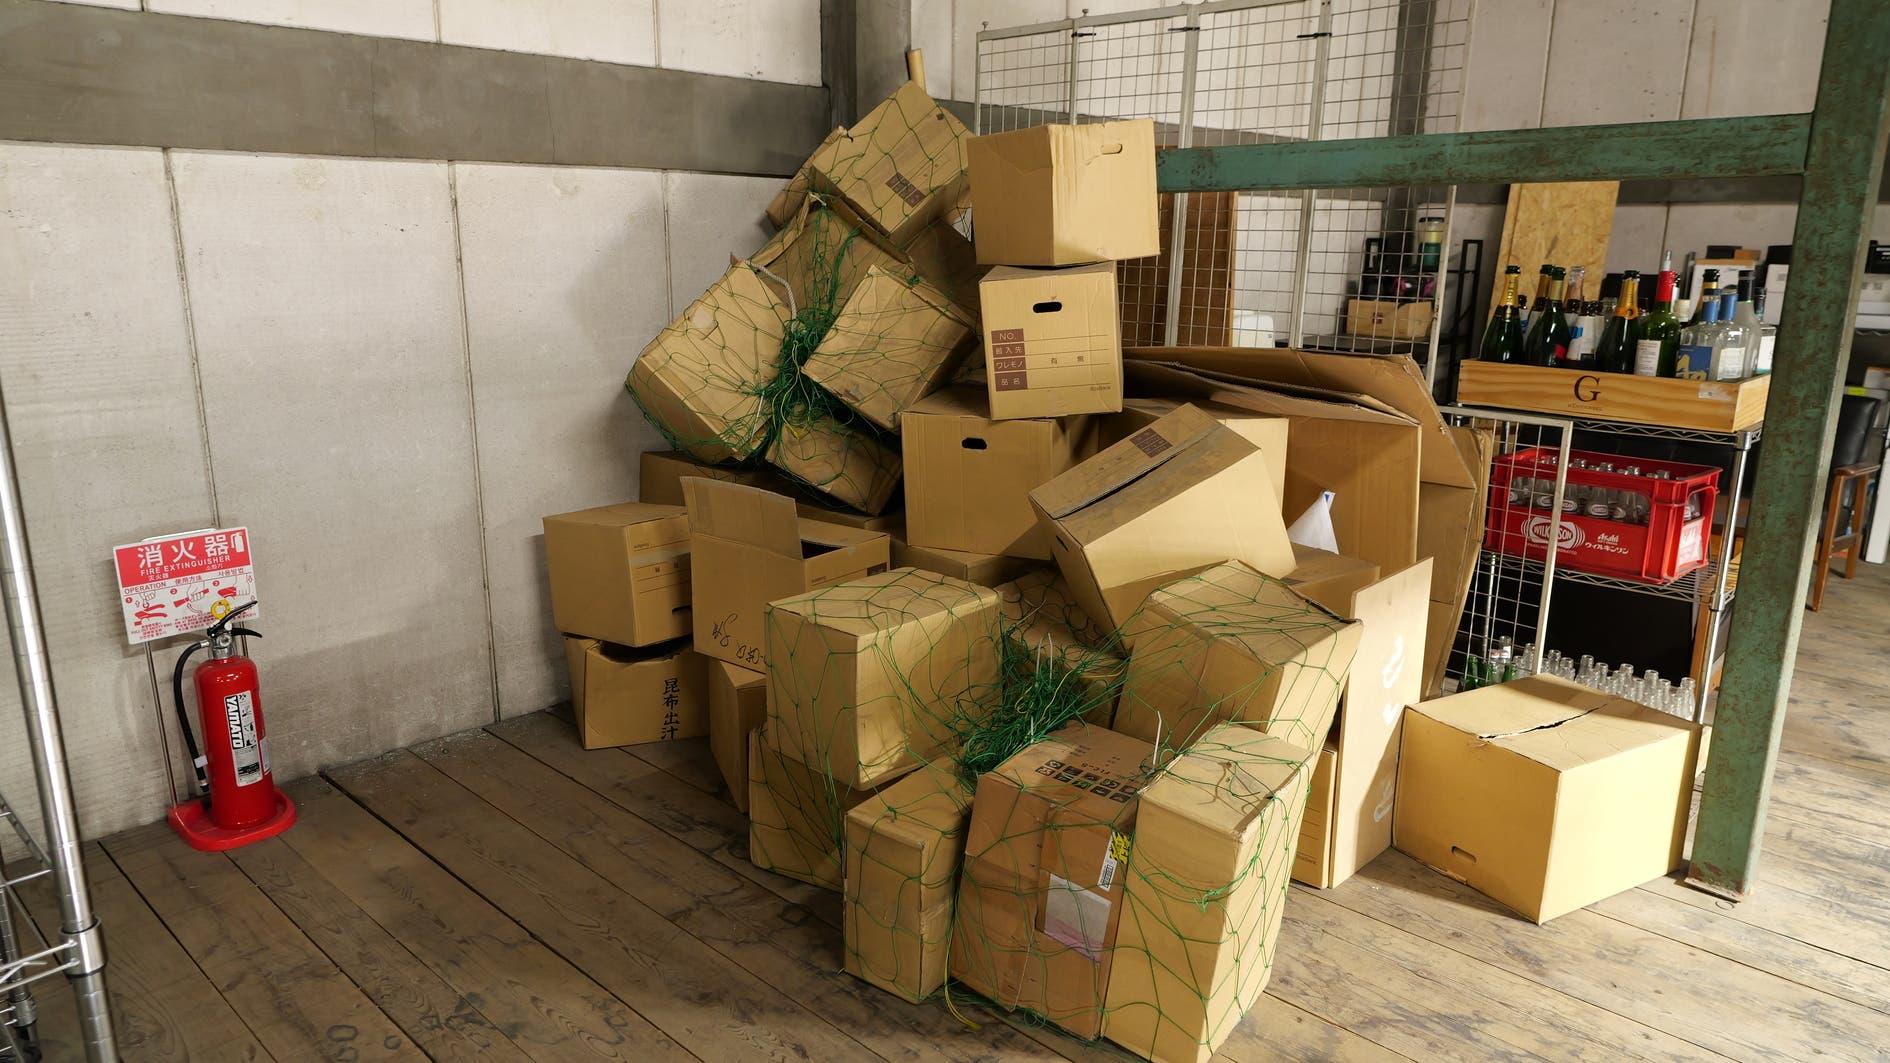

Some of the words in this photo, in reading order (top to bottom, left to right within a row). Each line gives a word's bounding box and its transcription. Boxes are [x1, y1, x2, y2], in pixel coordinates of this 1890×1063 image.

[999, 332, 1017, 341] NO.
[995, 360, 1023, 370] ワレモノ
[1573, 375, 1601, 402] G
[1533, 524, 1573, 540] WILKSON
[1597, 532, 1619, 543] Asahi
[137, 534, 229, 569] 消火器
[140, 567, 161, 577] FIRE
[164, 555, 231, 573] EXTINGUISHER
[124, 581, 167, 595] OPERATION
[661, 677, 680, 741] 昆布出汁
[226, 695, 244, 748] YAMATO
